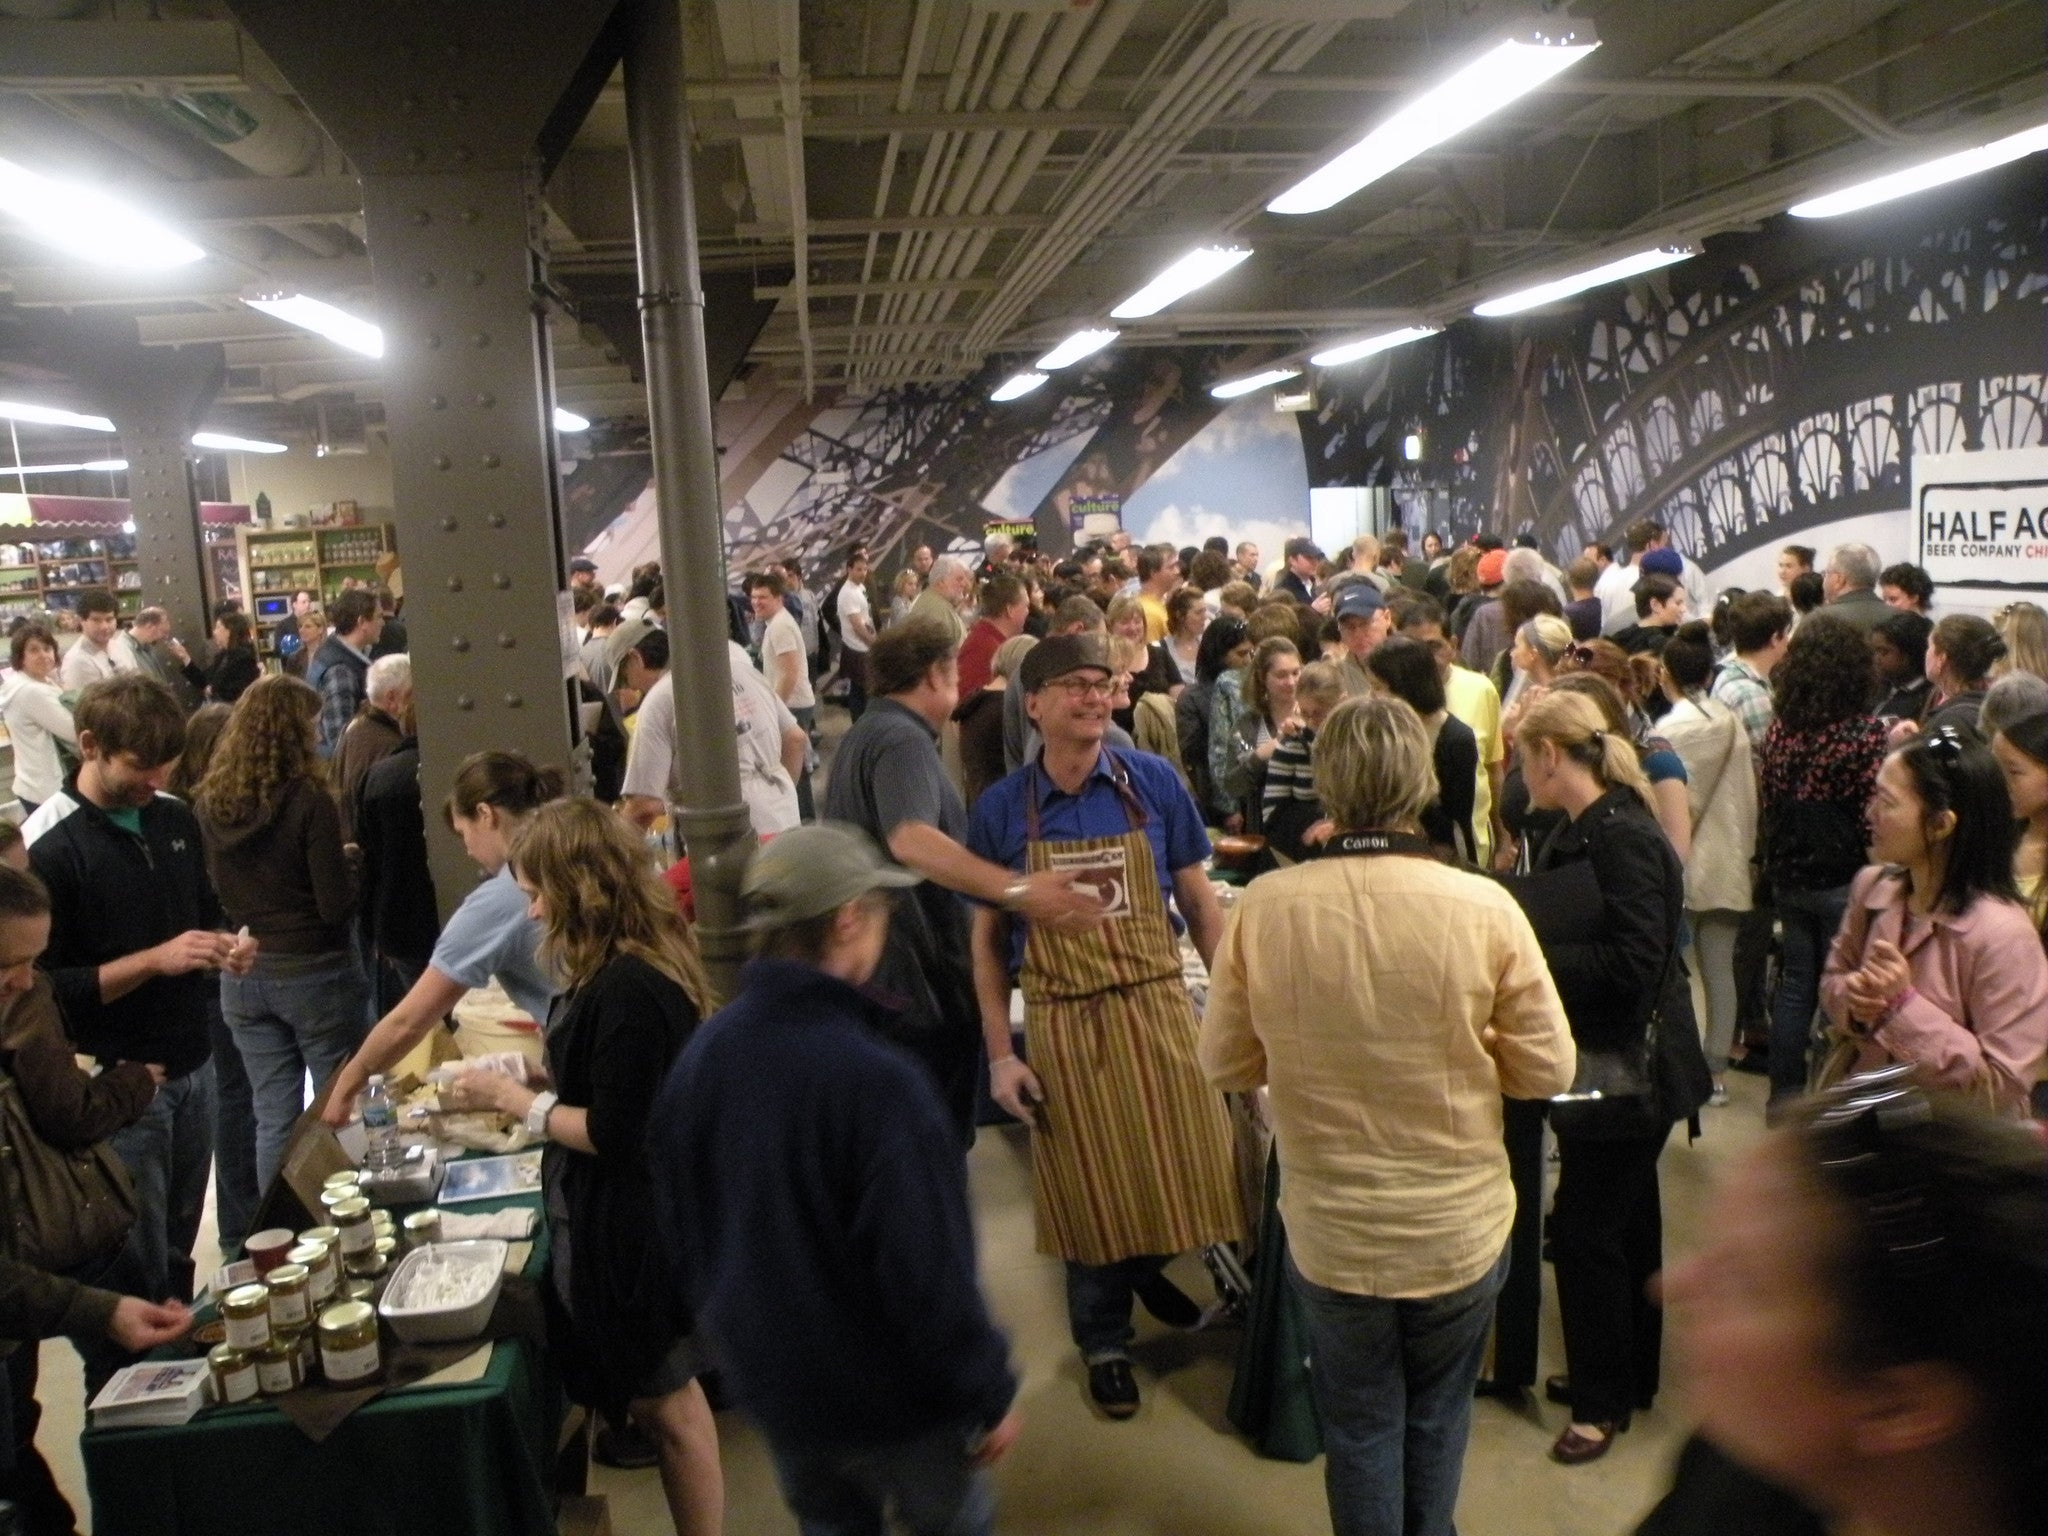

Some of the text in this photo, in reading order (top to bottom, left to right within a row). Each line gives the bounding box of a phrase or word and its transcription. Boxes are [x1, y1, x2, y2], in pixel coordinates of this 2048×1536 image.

[1071, 500, 1119, 513] culture
[985, 523, 1034, 536] culture
[1927, 511, 2007, 542] HALF
[1926, 544, 1956, 557] BEER
[1961, 544, 2022, 558] COMPANY
[1342, 835, 1389, 850] Canon
